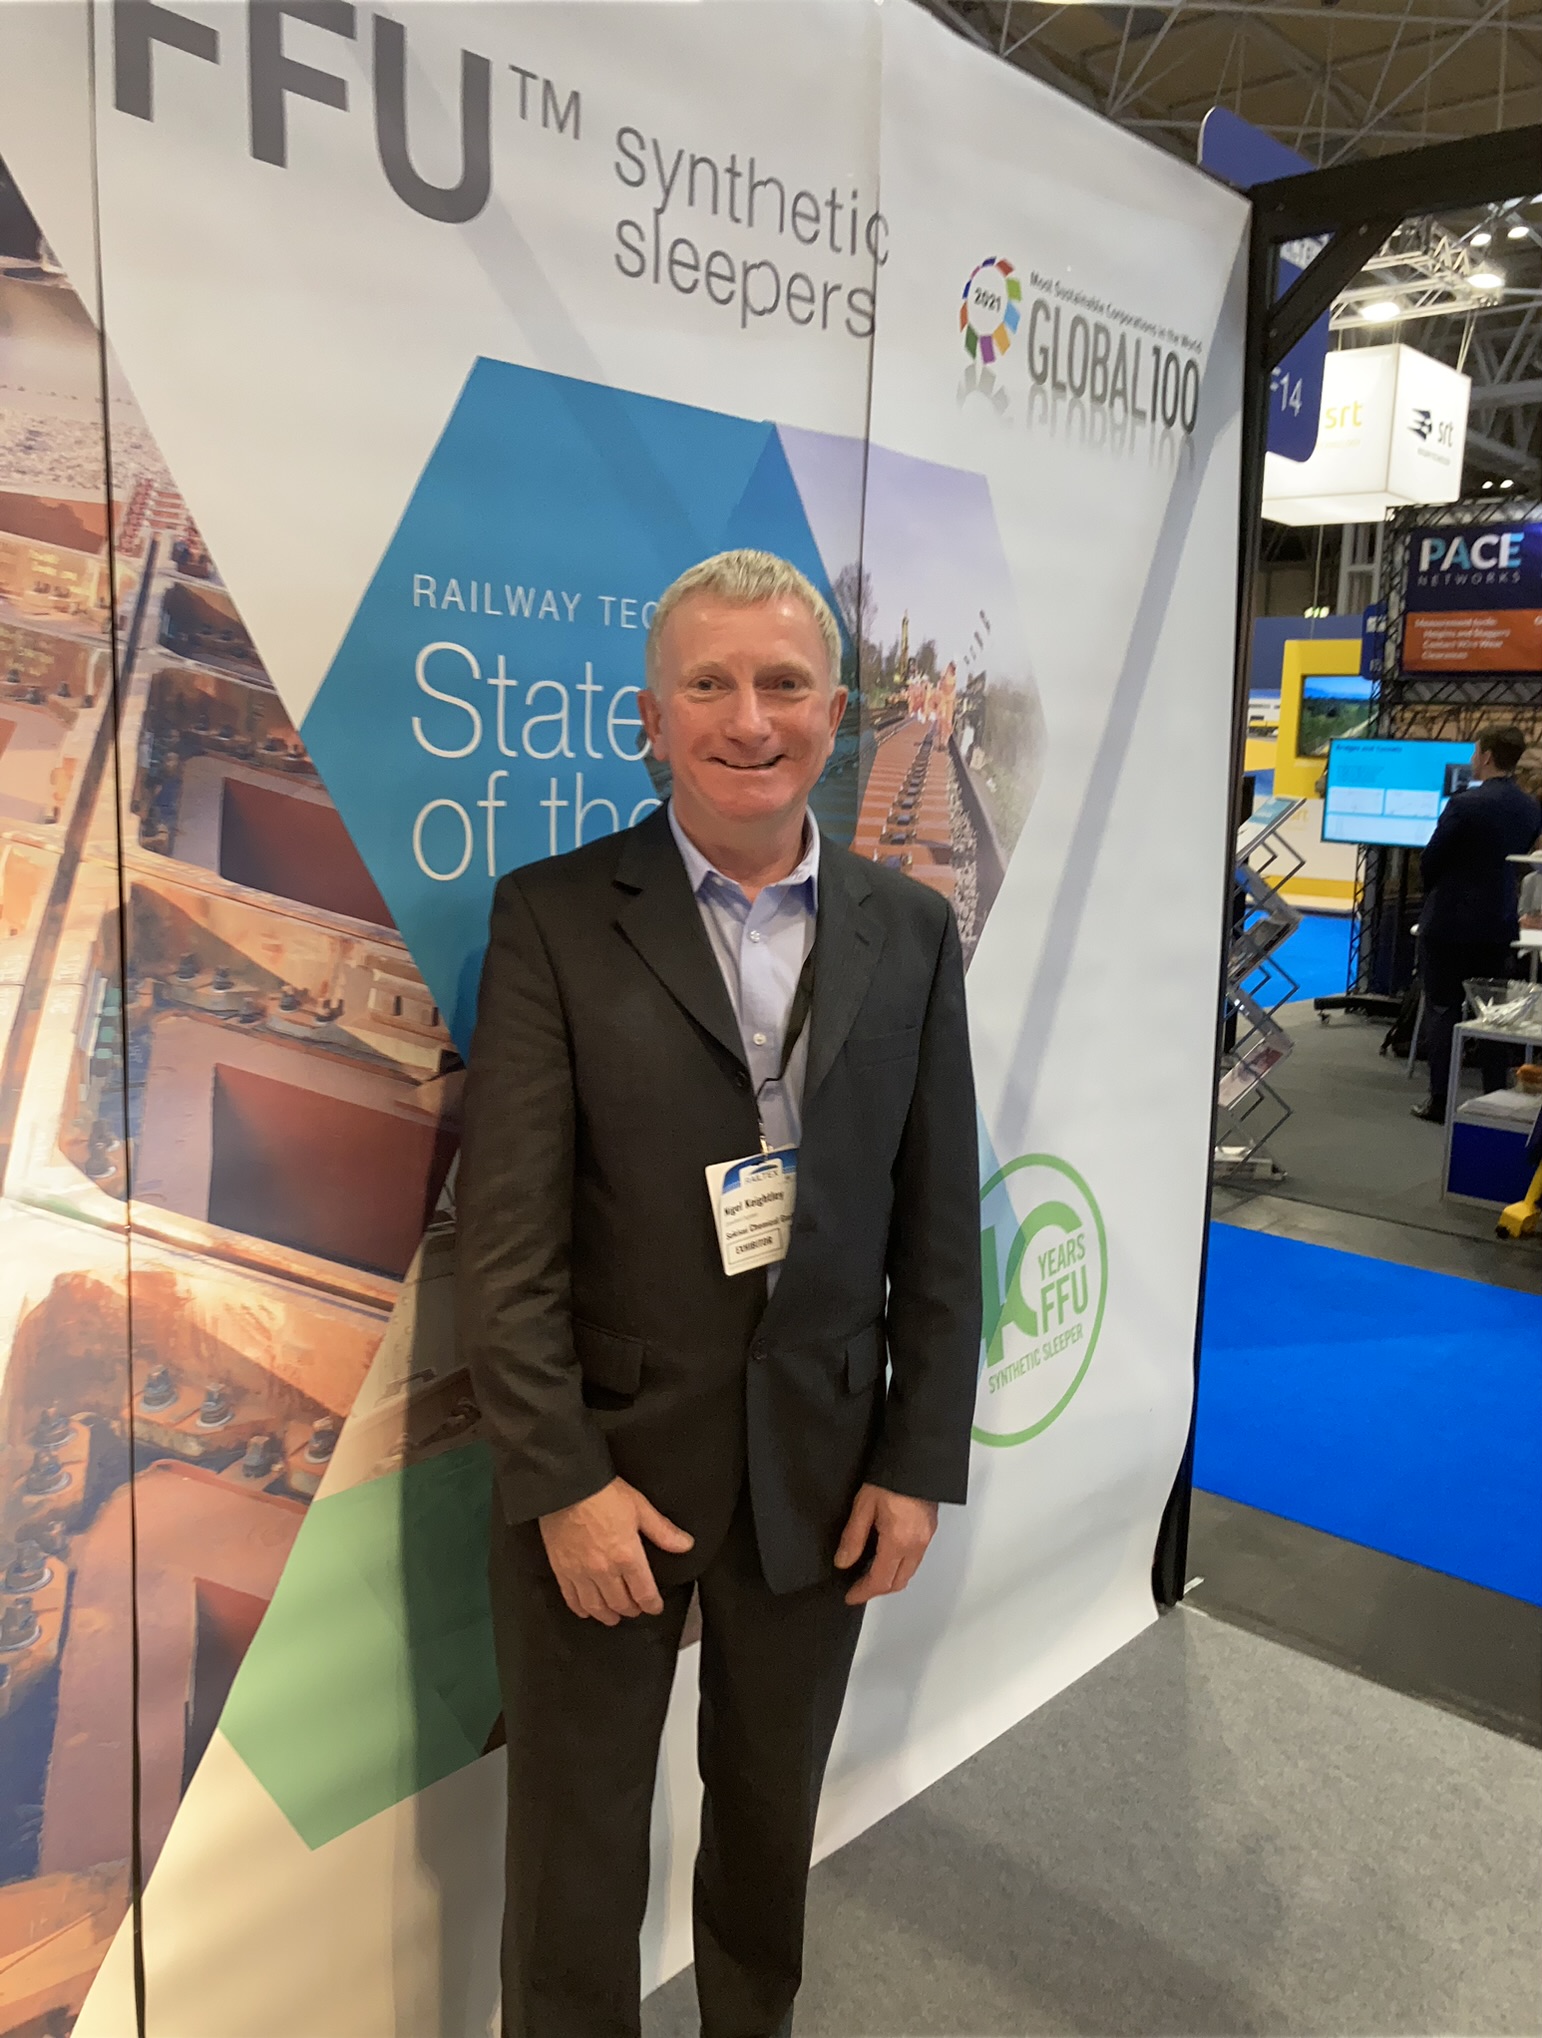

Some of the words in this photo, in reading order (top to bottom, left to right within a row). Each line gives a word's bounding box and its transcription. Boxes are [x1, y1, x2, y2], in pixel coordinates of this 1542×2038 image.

[614, 126, 890, 264] synthetic
[614, 206, 877, 338] sleepers
[1029, 270, 1053, 293] Most
[975, 286, 1001, 313] 2021
[1325, 400, 1362, 429] srt
[1438, 420, 1453, 448] srt
[1419, 532, 1525, 572] PACE
[412, 573, 582, 623] RAILWAY
[1417, 570, 1521, 587] NETWORKS
[411, 640, 651, 762] State
[412, 770, 509, 882] of
[724, 1201, 743, 1216] Nigel
[735, 1235, 773, 1255] EXHIBITOR
[1037, 1233, 1085, 1281] YEARS
[1040, 1264, 1089, 1335] FFU
[988, 1348, 1041, 1394] SYNTHETIC
[1042, 1323, 1083, 1361] SLEEPER
